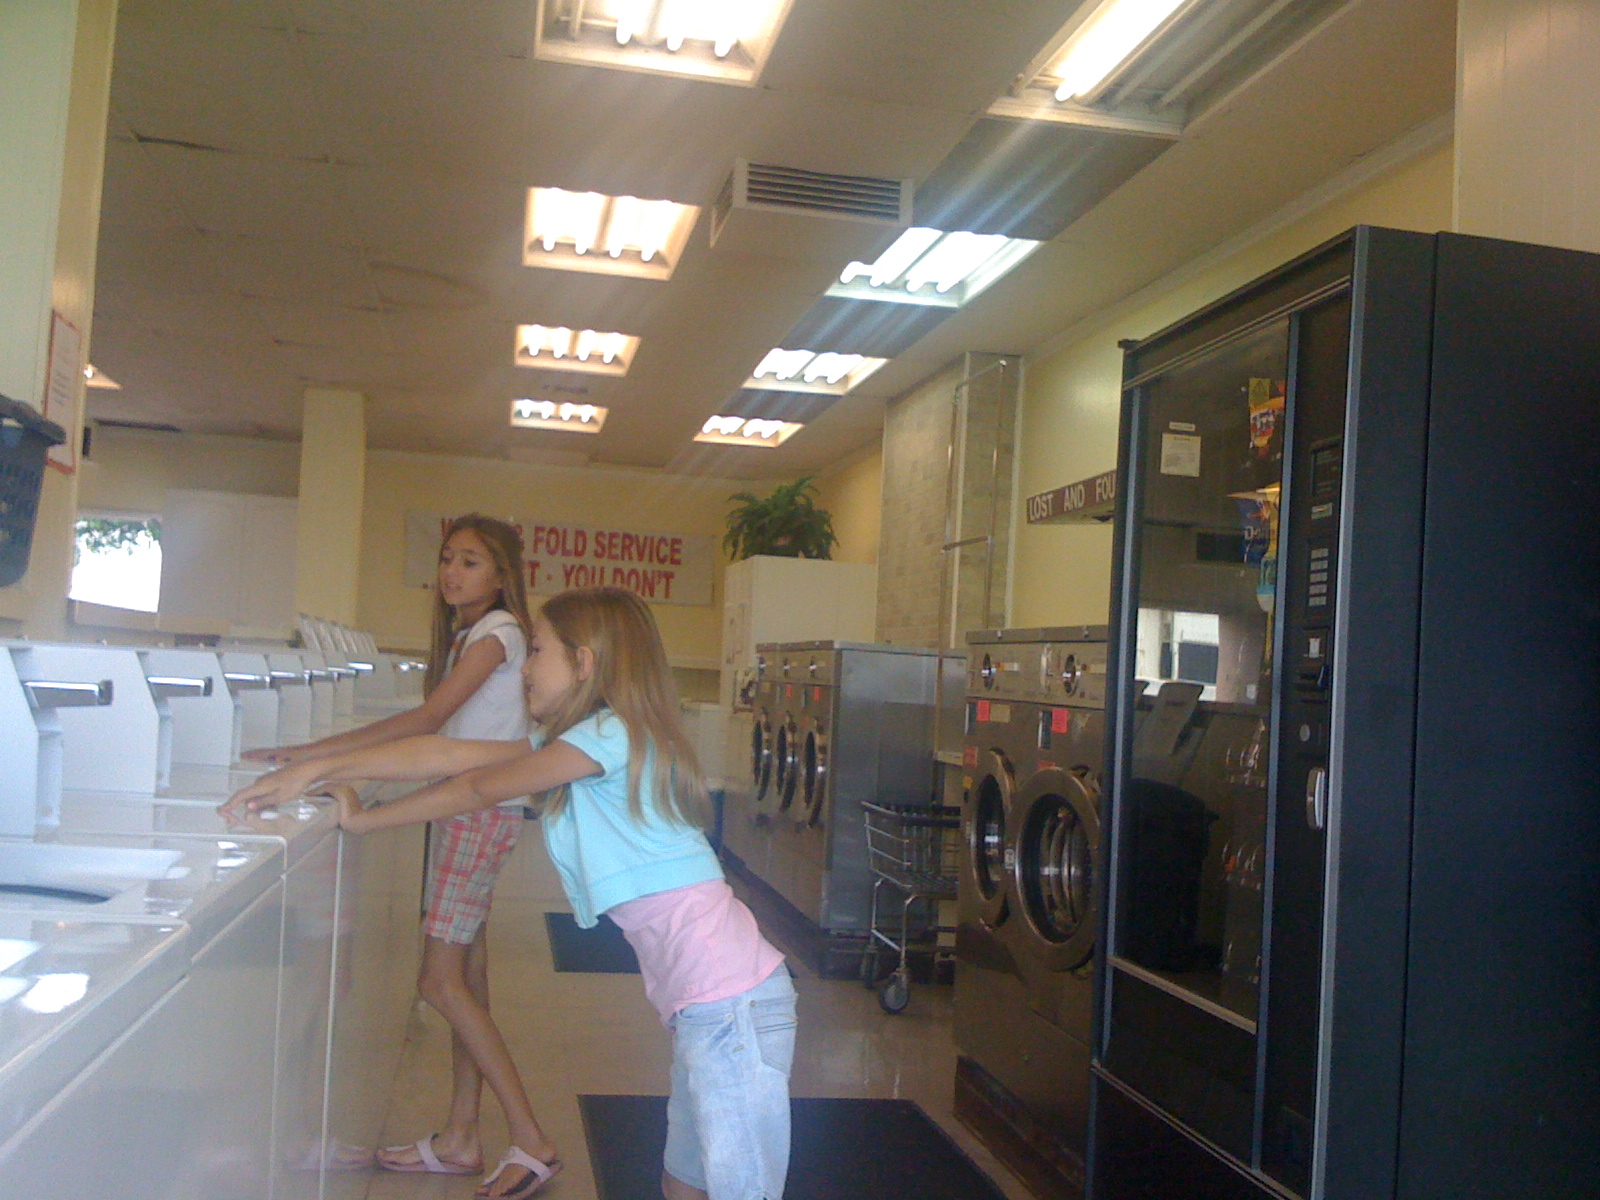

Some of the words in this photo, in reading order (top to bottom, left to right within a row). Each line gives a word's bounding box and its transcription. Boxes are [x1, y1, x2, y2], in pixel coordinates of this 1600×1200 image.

[1029, 493, 1054, 521] LOST
[1063, 483, 1086, 512] AND
[1095, 473, 1117, 503] FOU
[533, 525, 588, 558] FOLD
[594, 530, 683, 566] SERVICE
[563, 563, 605, 588] YOU
